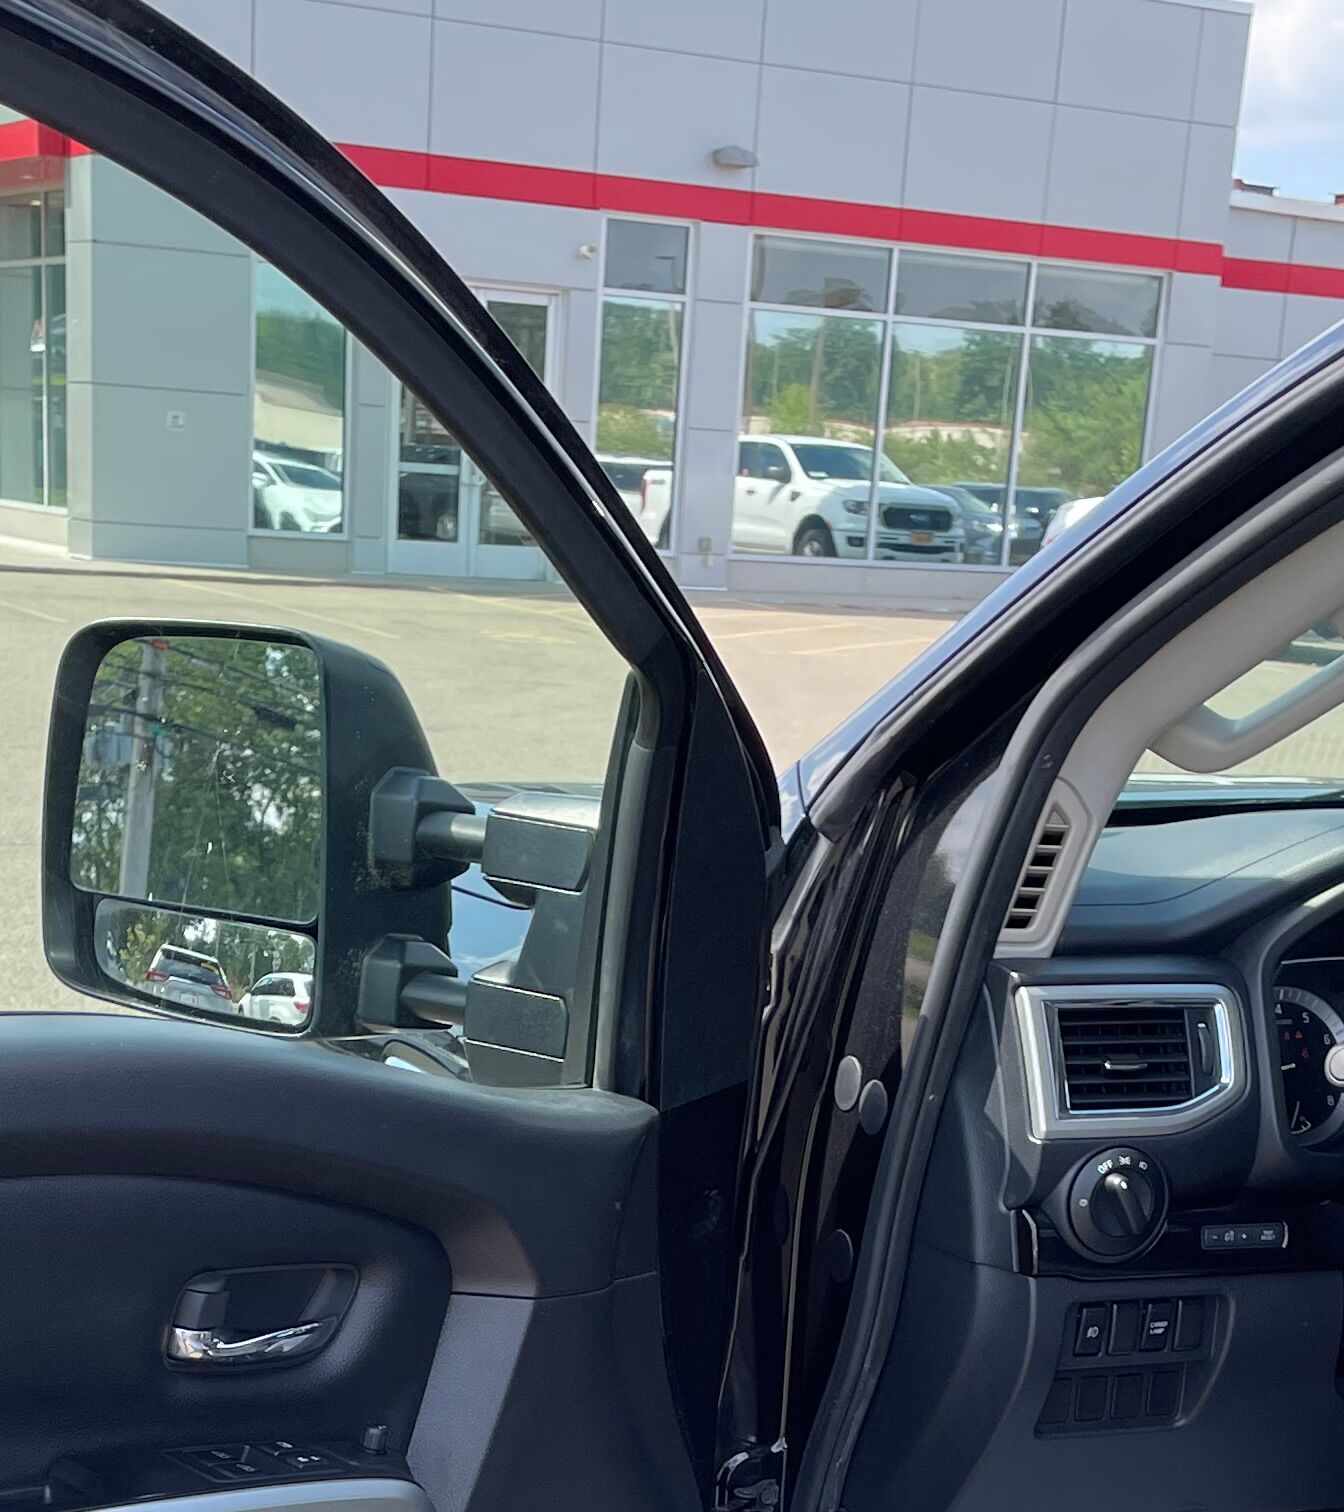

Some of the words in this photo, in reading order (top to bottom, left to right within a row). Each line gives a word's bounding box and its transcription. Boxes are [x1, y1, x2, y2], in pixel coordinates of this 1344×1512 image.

[1302, 1012, 1309, 1024] 5
[1323, 1034, 1331, 1045] 6
[1327, 1095, 1334, 1106] 8
[1097, 1159, 1113, 1174] OFF
